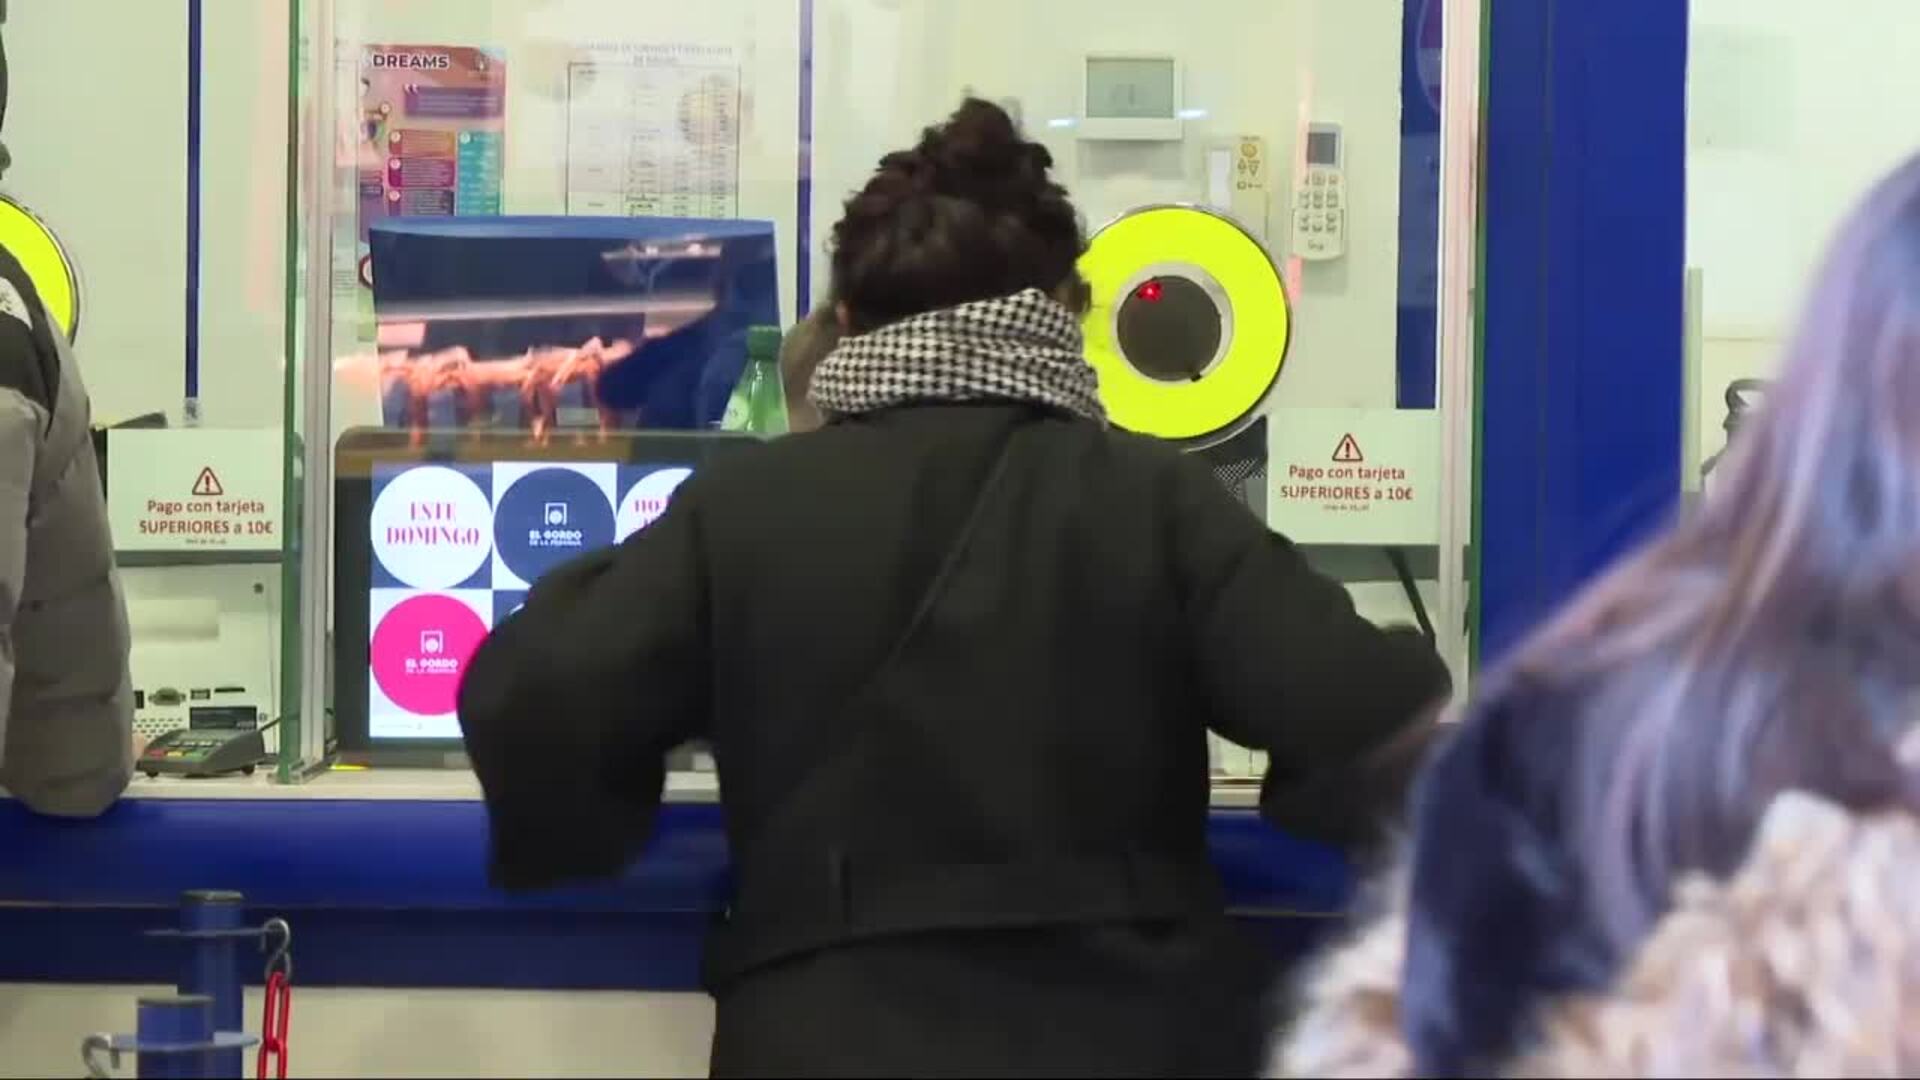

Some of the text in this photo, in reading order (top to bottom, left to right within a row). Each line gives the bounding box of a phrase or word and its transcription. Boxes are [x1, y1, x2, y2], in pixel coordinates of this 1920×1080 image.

[373, 54, 449, 69] DREAMS
[1289, 465, 1405, 482] Pago con tarjeta
[1280, 485, 1413, 501] SUPERIORES a 10€
[147, 500, 264, 516] Pago con tarjeta
[410, 502, 457, 521] ESTE
[139, 520, 273, 534] SUPERIORES a 10€
[529, 530, 582, 540] EL GORDO
[387, 526, 480, 546] DOMINGO
[405, 658, 458, 668] EL GORDO
